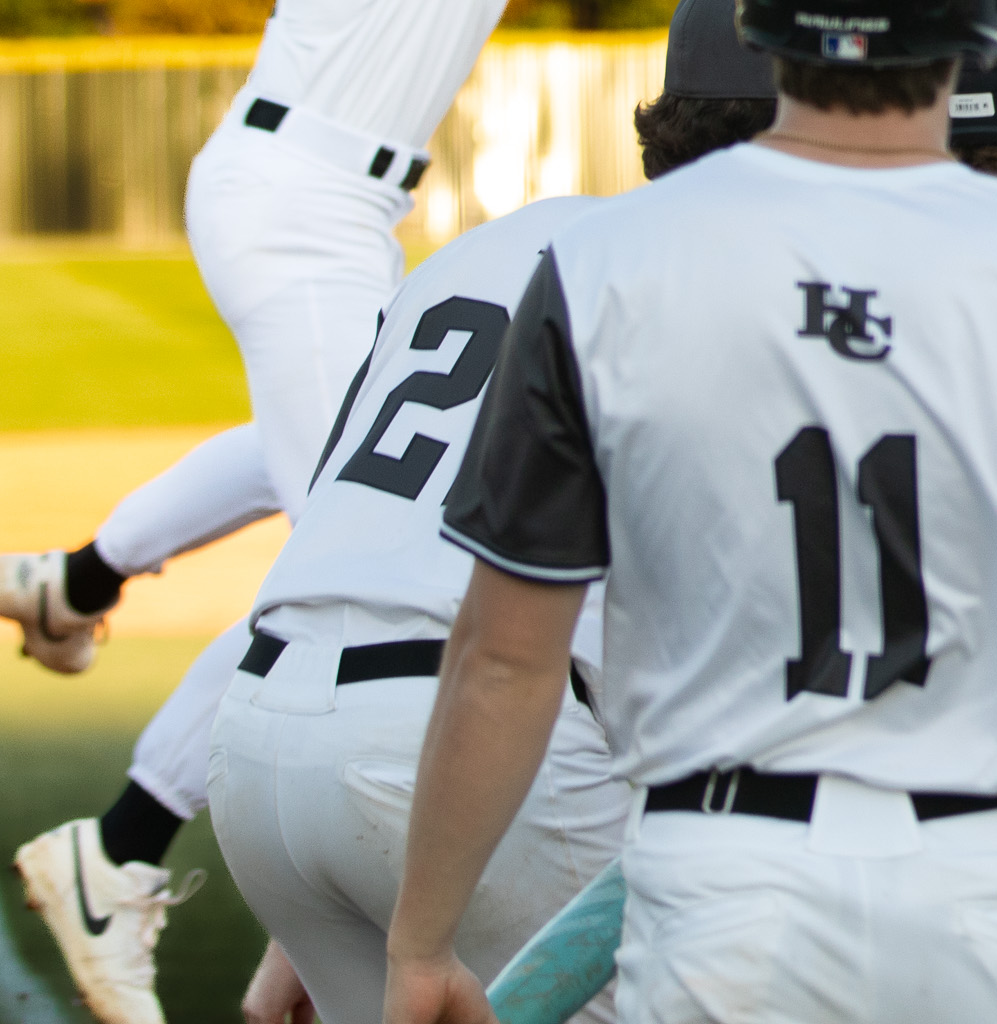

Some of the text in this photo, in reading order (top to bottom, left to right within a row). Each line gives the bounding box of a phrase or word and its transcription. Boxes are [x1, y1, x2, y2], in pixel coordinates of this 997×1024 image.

[335, 295, 511, 506] 2
[796, 281, 893, 361] HC
[774, 426, 932, 702] 11
